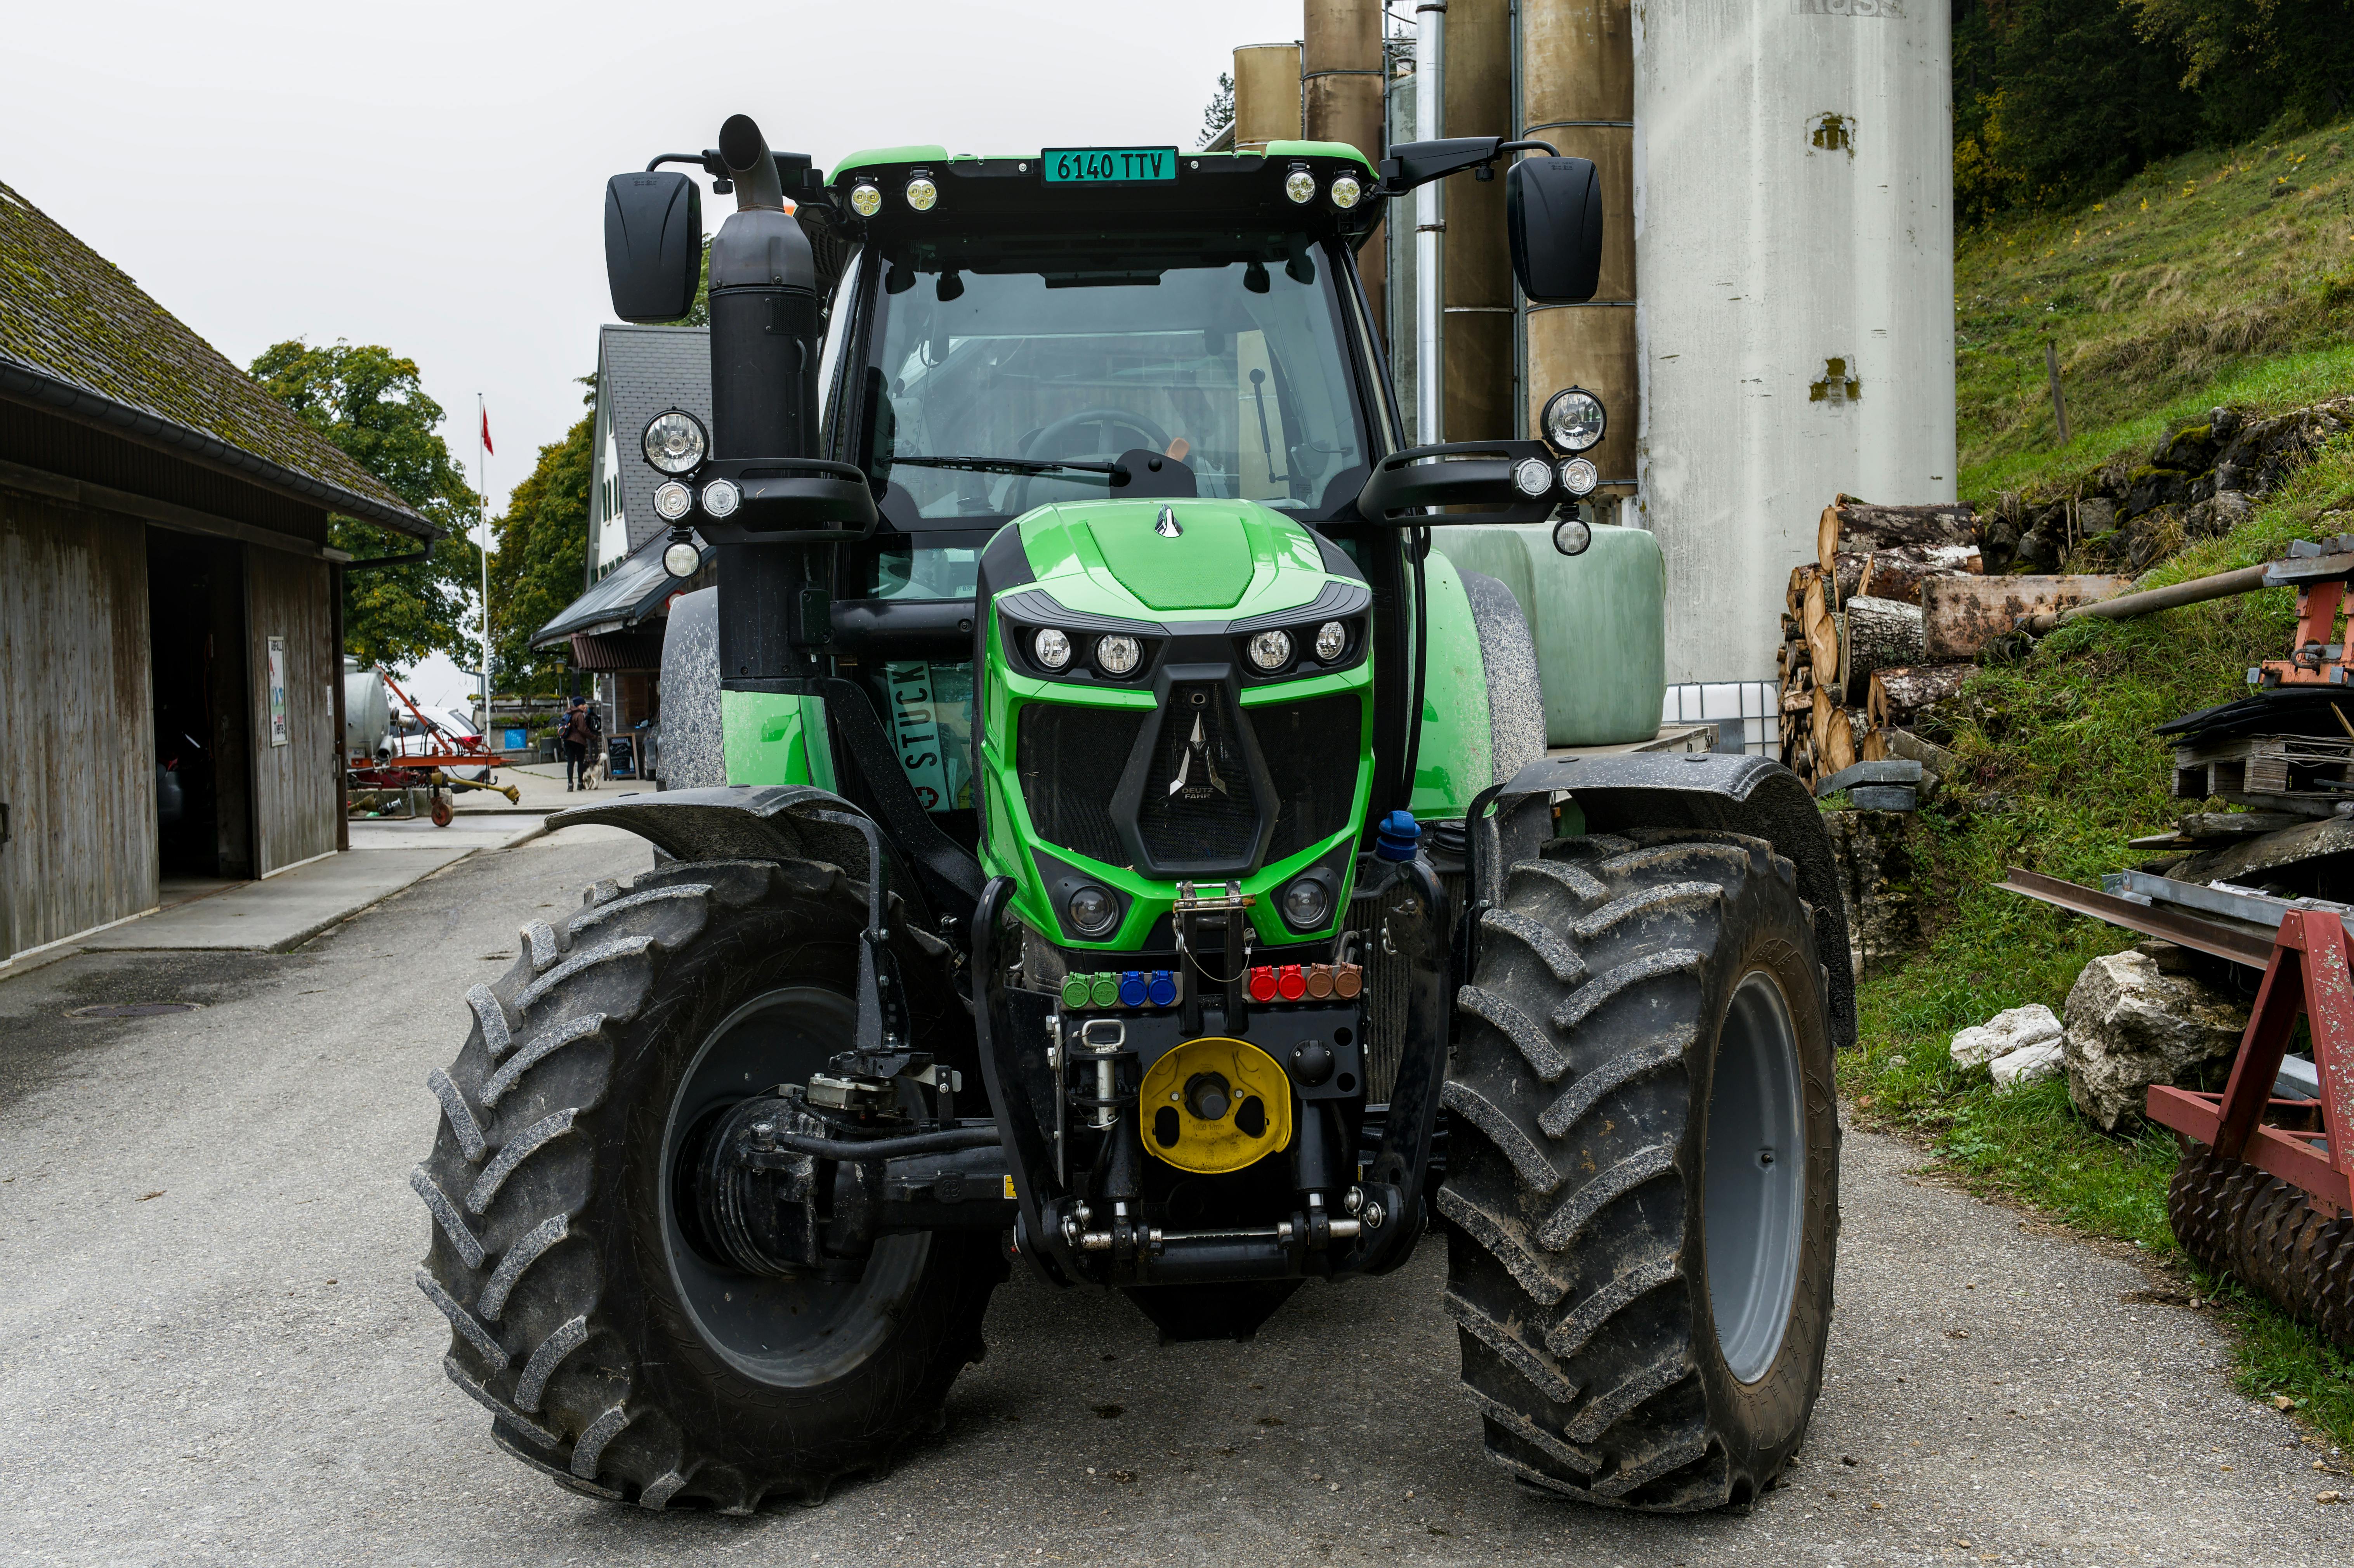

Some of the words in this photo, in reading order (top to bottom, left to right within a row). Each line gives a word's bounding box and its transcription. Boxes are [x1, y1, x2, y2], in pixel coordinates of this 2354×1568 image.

[1057, 153, 1113, 179] 6140
[1121, 153, 1162, 178] TTV
[892, 665, 937, 769] STUCK
